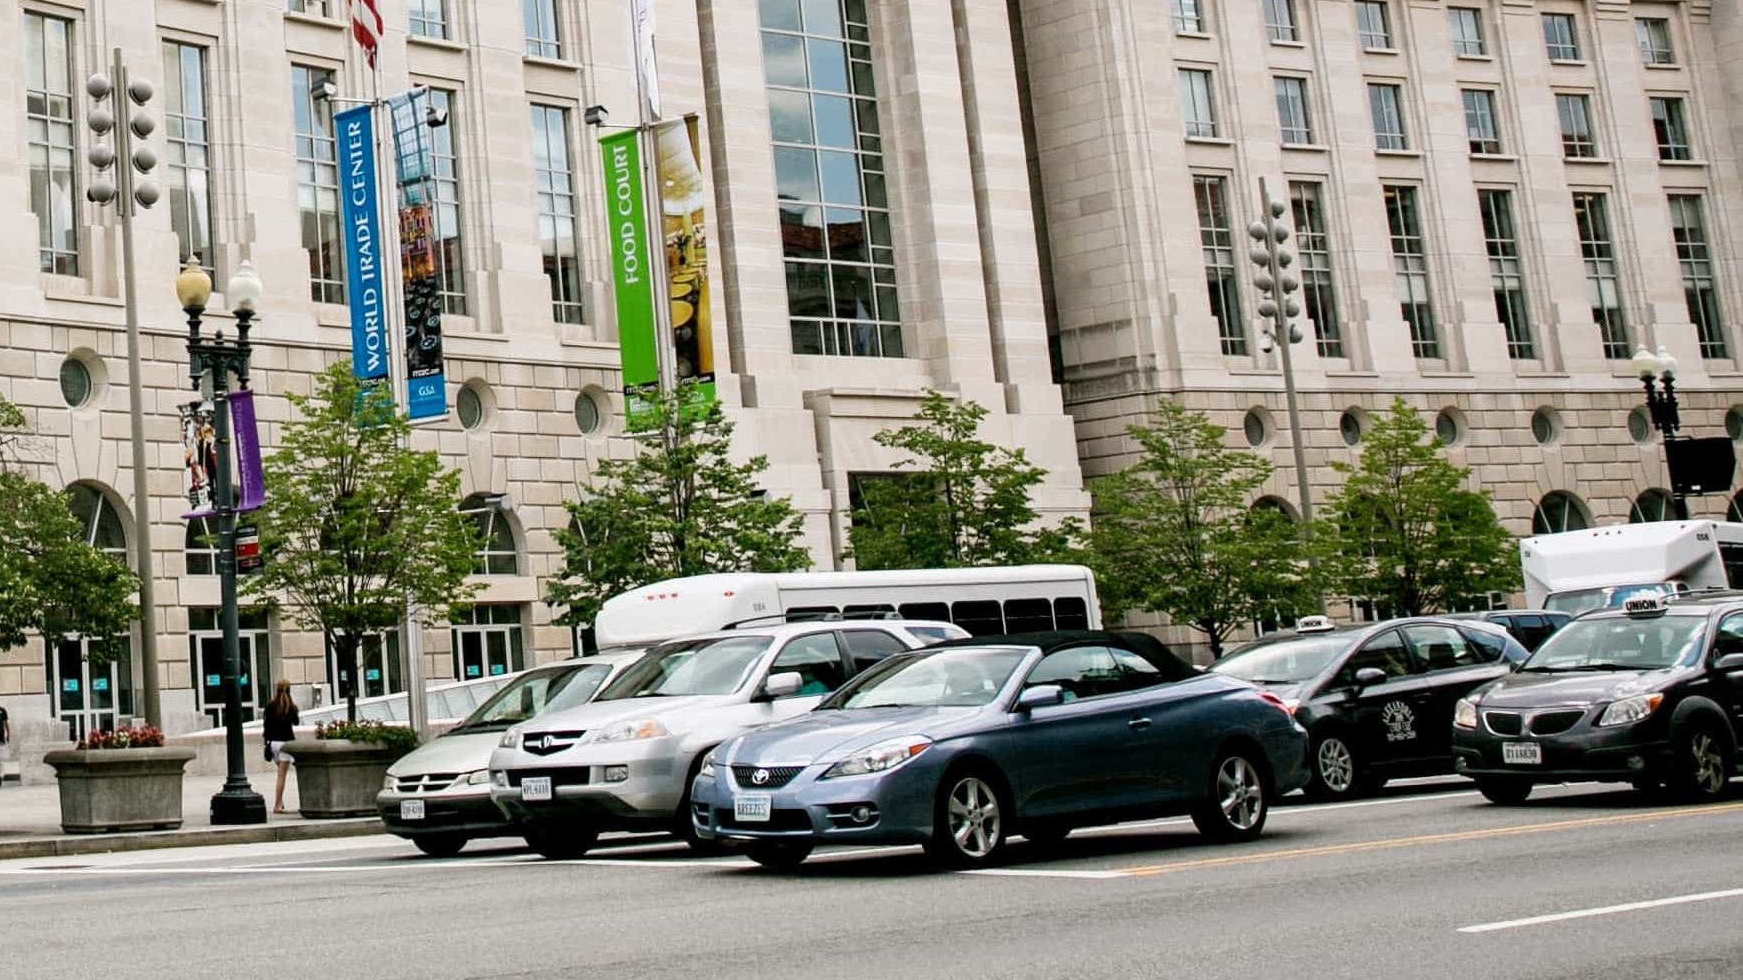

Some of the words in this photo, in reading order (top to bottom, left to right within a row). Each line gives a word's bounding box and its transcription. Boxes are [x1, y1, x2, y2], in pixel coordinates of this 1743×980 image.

[348, 121, 366, 207] CENTER
[613, 145, 632, 216] COURT
[356, 210, 374, 280] TRADE
[621, 222, 639, 284] FOOD
[364, 288, 380, 372] WORLD
[1626, 600, 1657, 611] UNION
